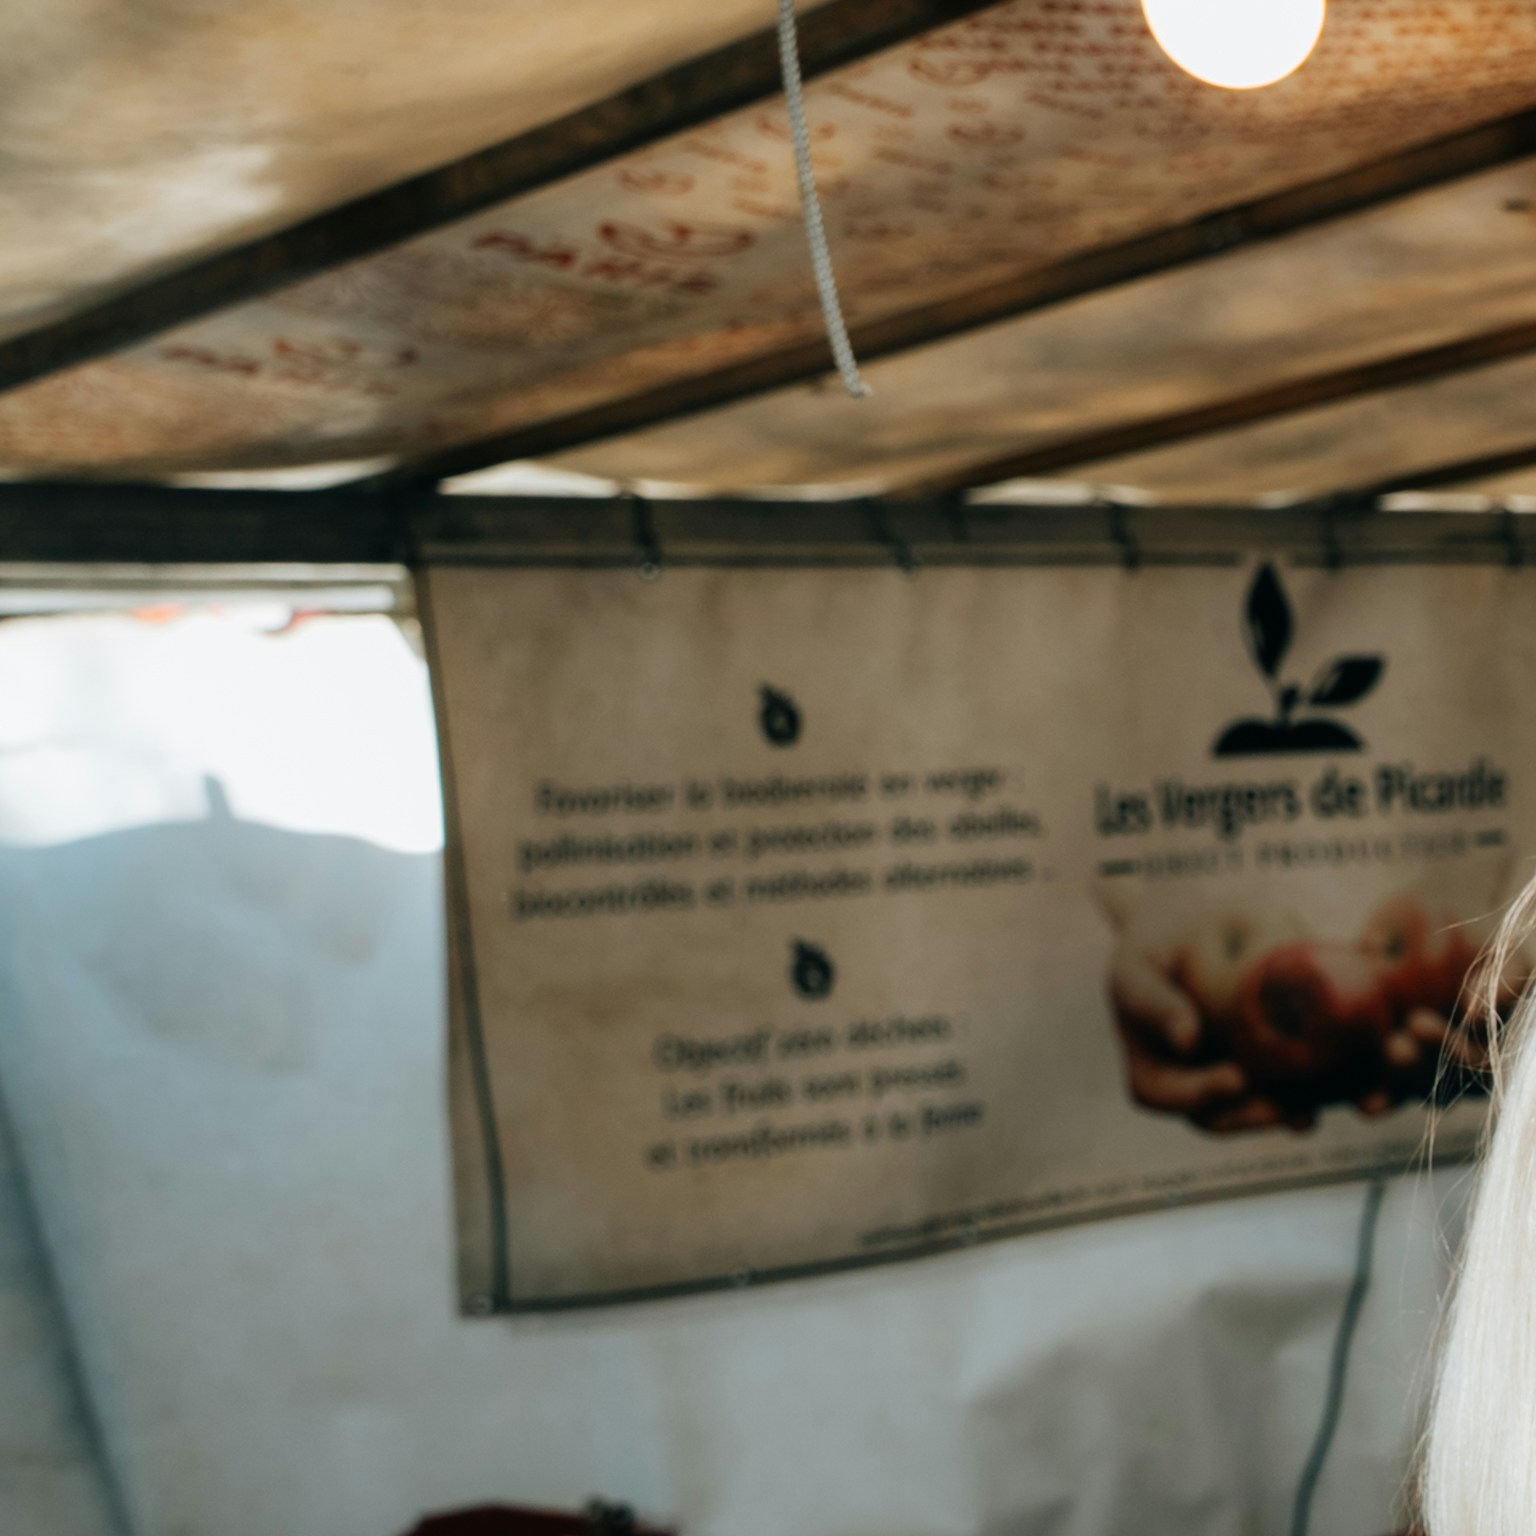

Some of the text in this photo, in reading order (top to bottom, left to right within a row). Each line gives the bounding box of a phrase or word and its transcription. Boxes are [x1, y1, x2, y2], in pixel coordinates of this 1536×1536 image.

[1097, 782, 1150, 834] Les
[1156, 776, 1300, 841] Vergers
[1313, 767, 1366, 816] de
